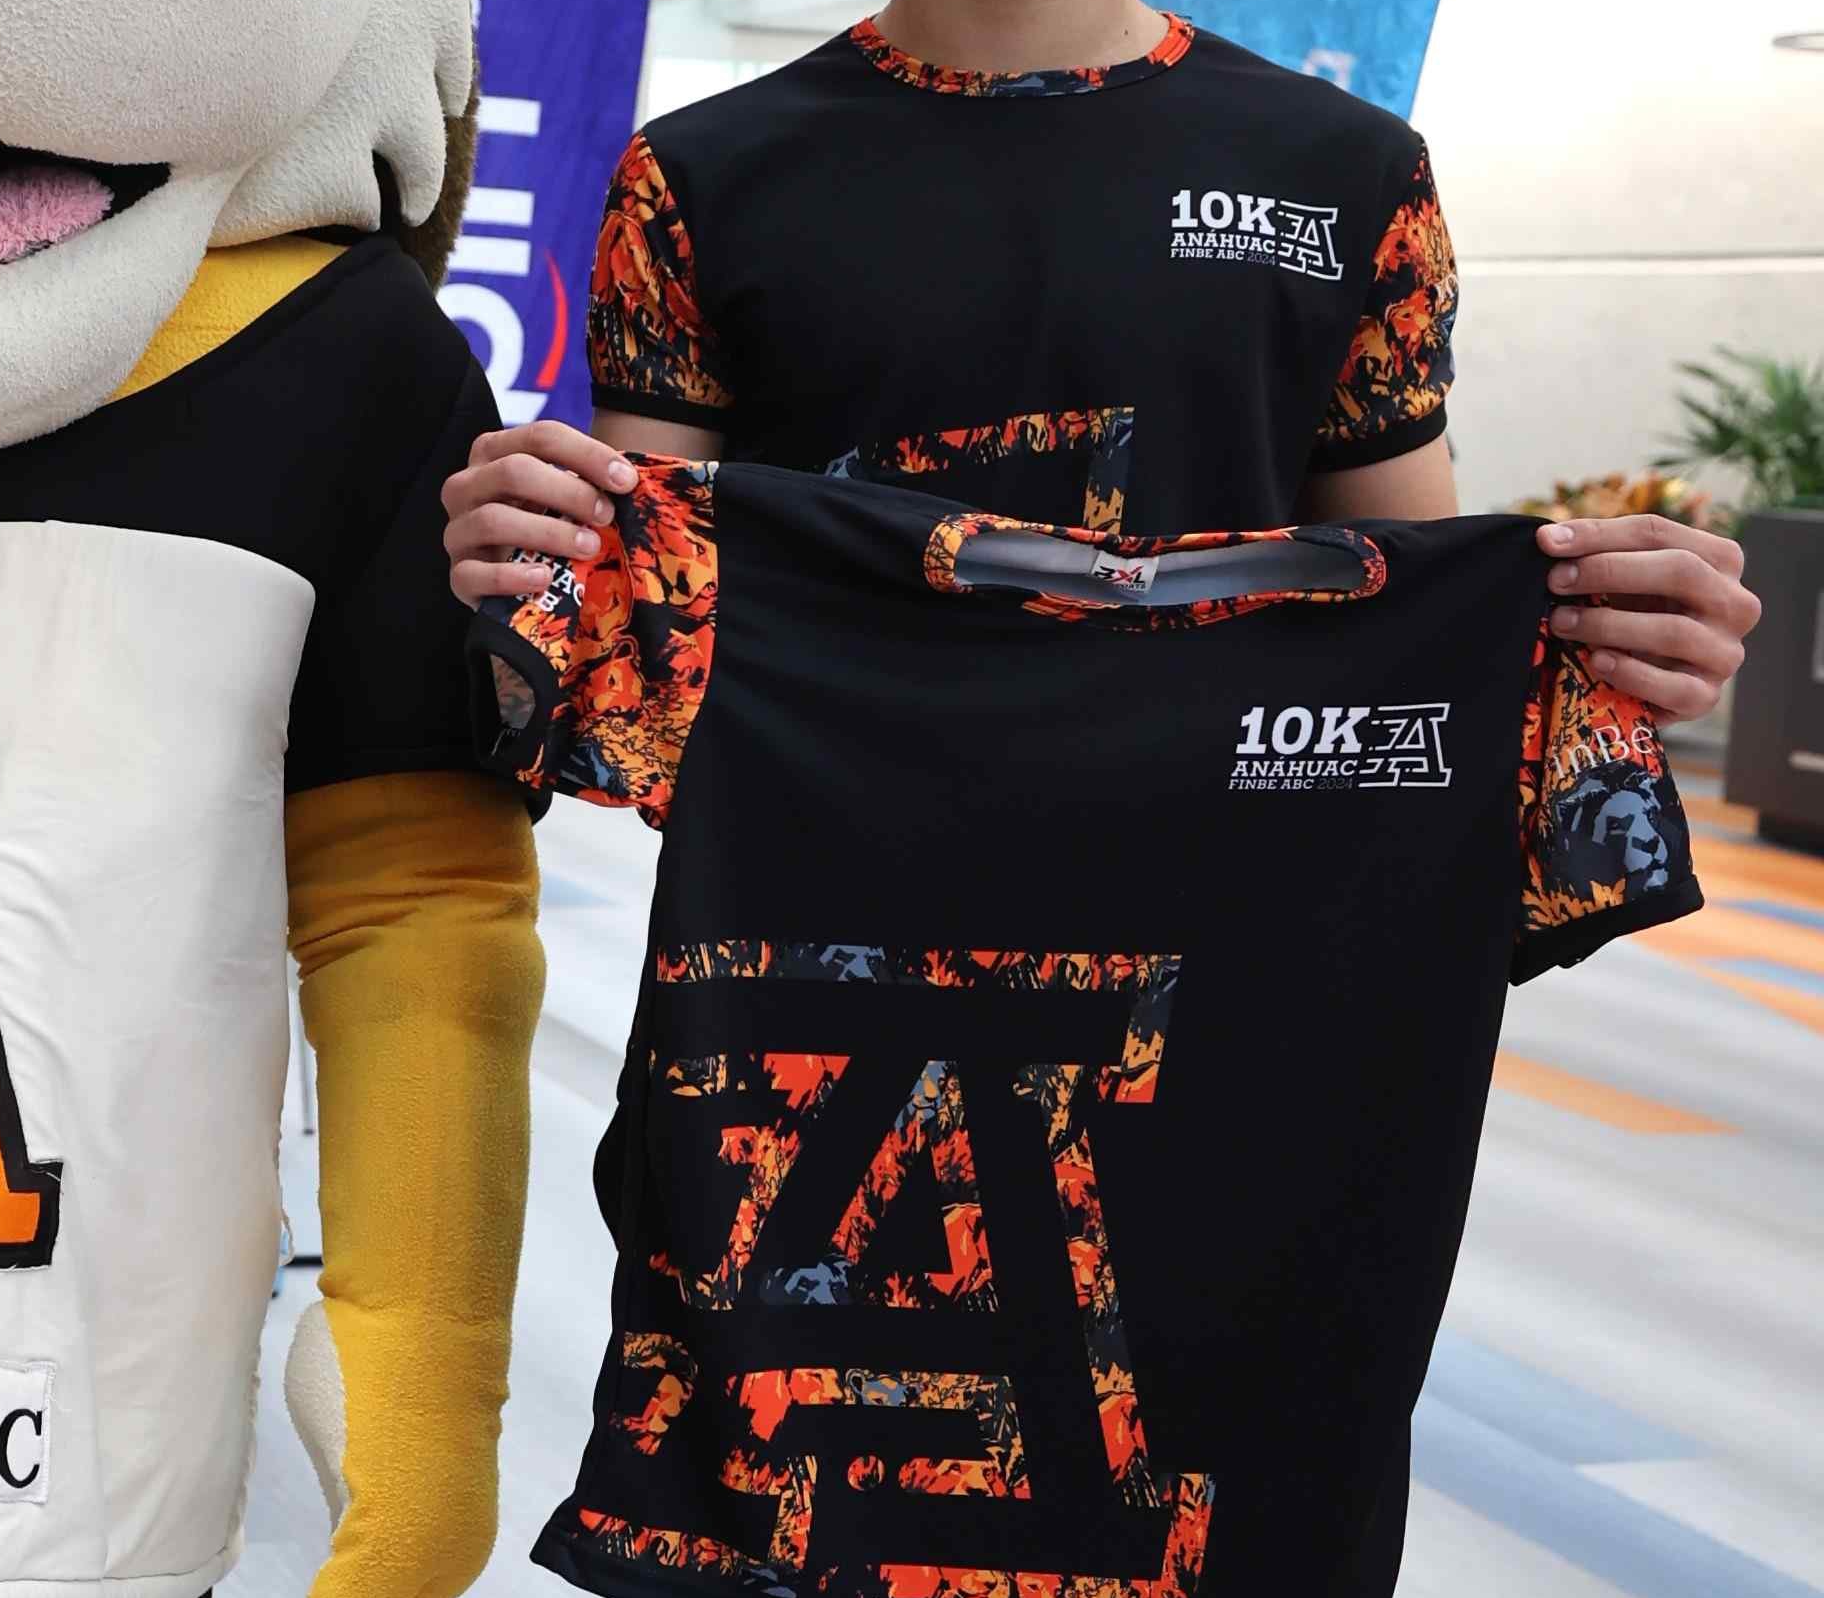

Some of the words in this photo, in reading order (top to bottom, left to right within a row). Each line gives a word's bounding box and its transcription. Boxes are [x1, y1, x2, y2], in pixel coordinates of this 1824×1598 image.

[1171, 189, 1277, 236] 10K
[1170, 230, 1277, 254] ANÁHUAC
[1170, 248, 1213, 258] FINBE
[1215, 249, 1244, 261] ABC
[1246, 253, 1277, 266] 2024
[1235, 706, 1371, 755] 10K
[1231, 756, 1358, 778] ANÁHUAC
[1228, 779, 1277, 790] FINBE
[1280, 779, 1314, 790] ABC
